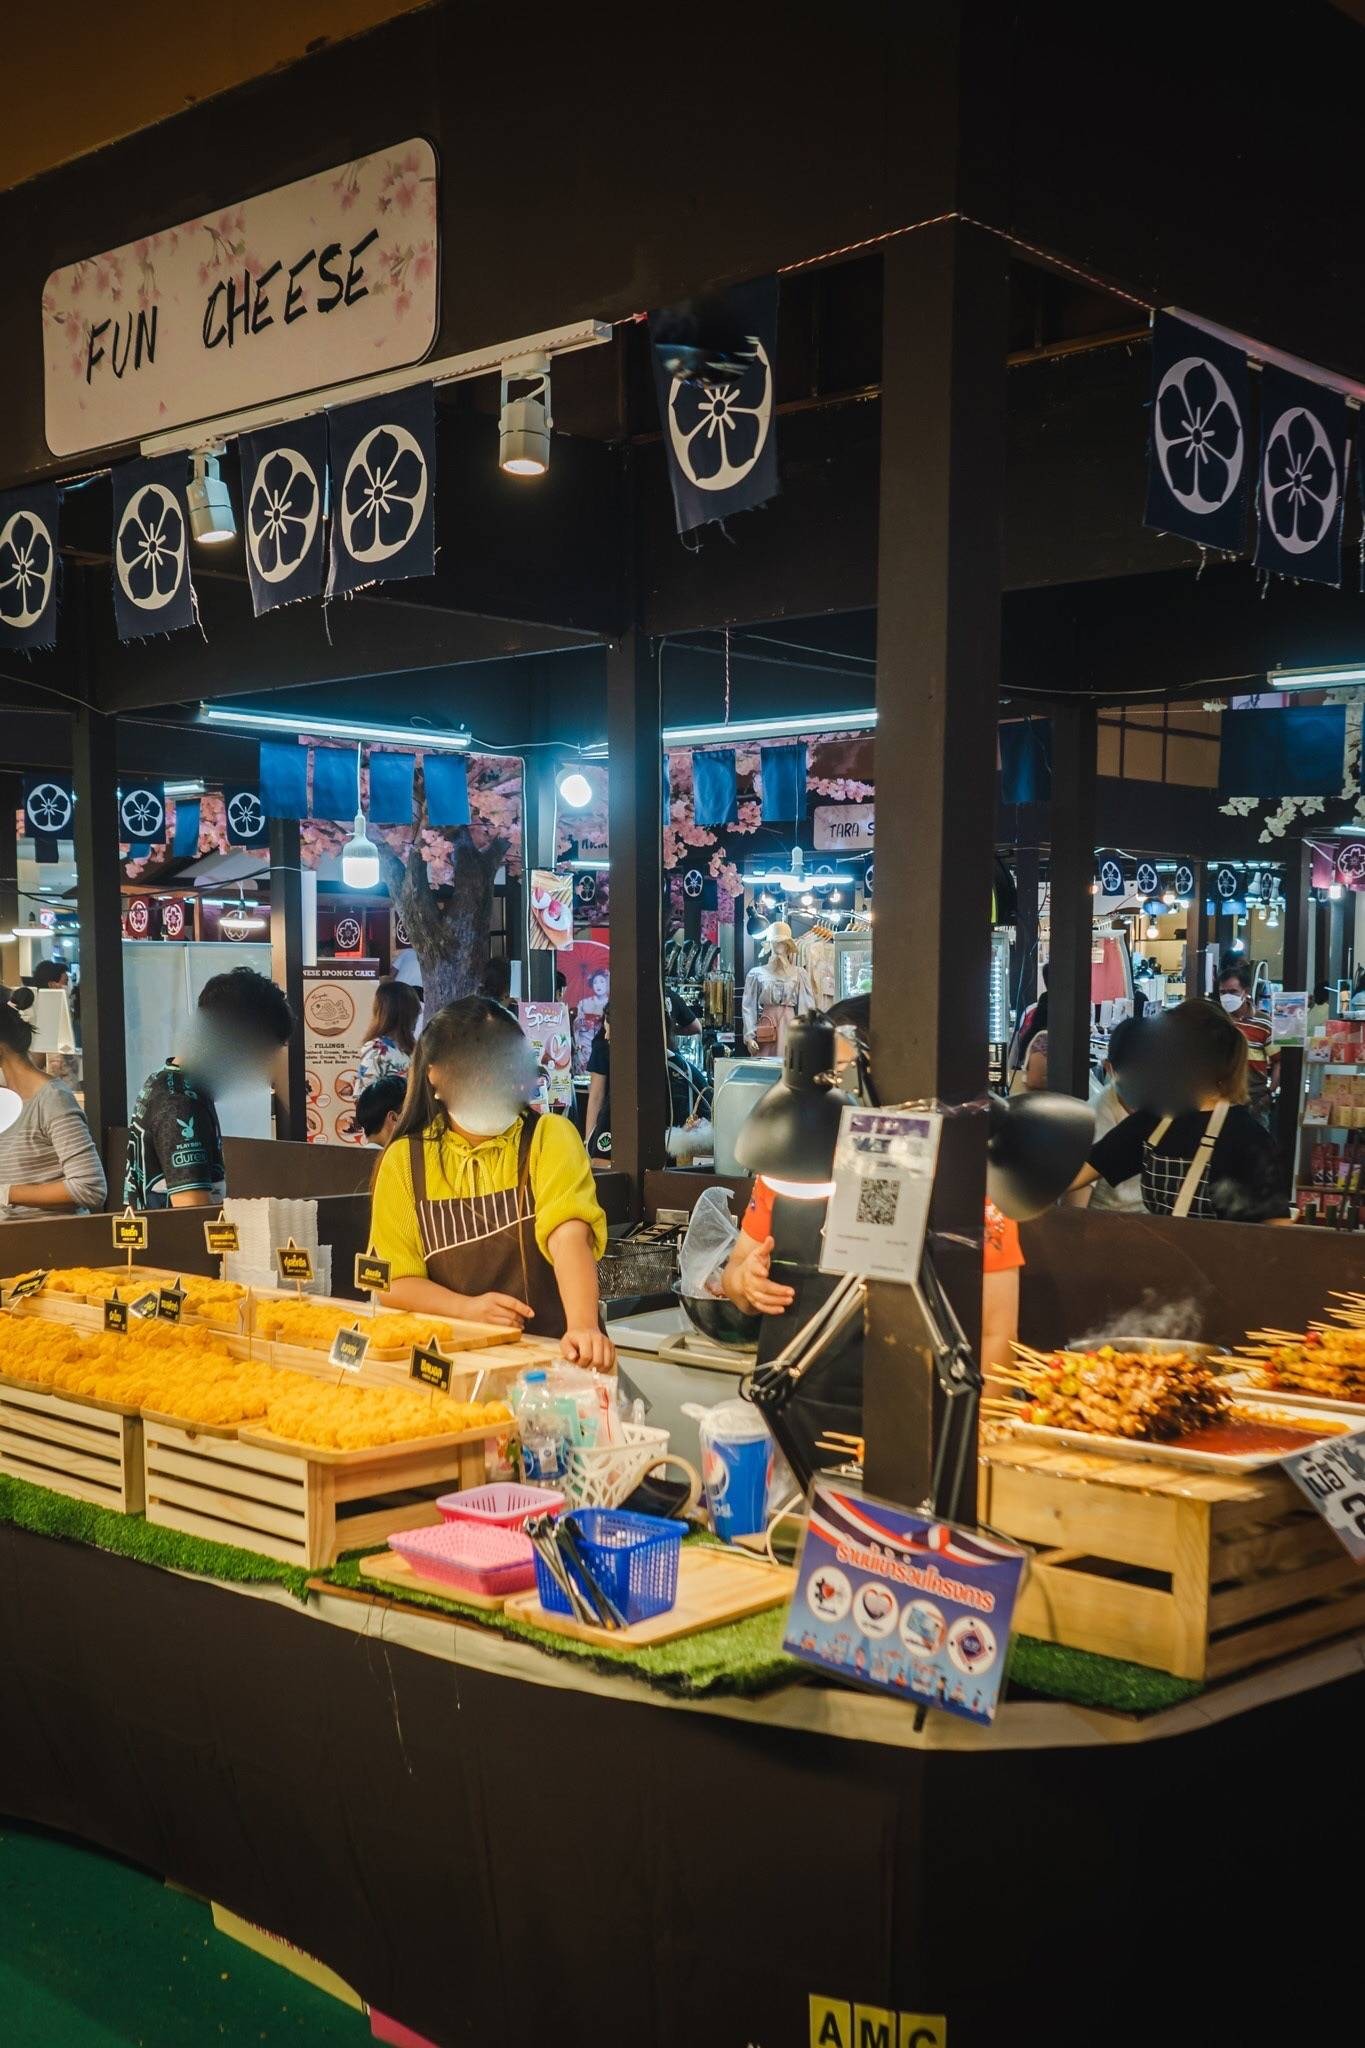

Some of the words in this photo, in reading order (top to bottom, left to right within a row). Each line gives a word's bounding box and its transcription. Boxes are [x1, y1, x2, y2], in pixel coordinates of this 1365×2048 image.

[86, 305, 158, 385] FUN
[202, 228, 379, 349] CHEESE
[830, 822, 860, 838] TARA
[322, 969, 354, 977] SPONGE
[354, 969, 376, 977] CAKE
[175, 1152, 209, 1165] dure
